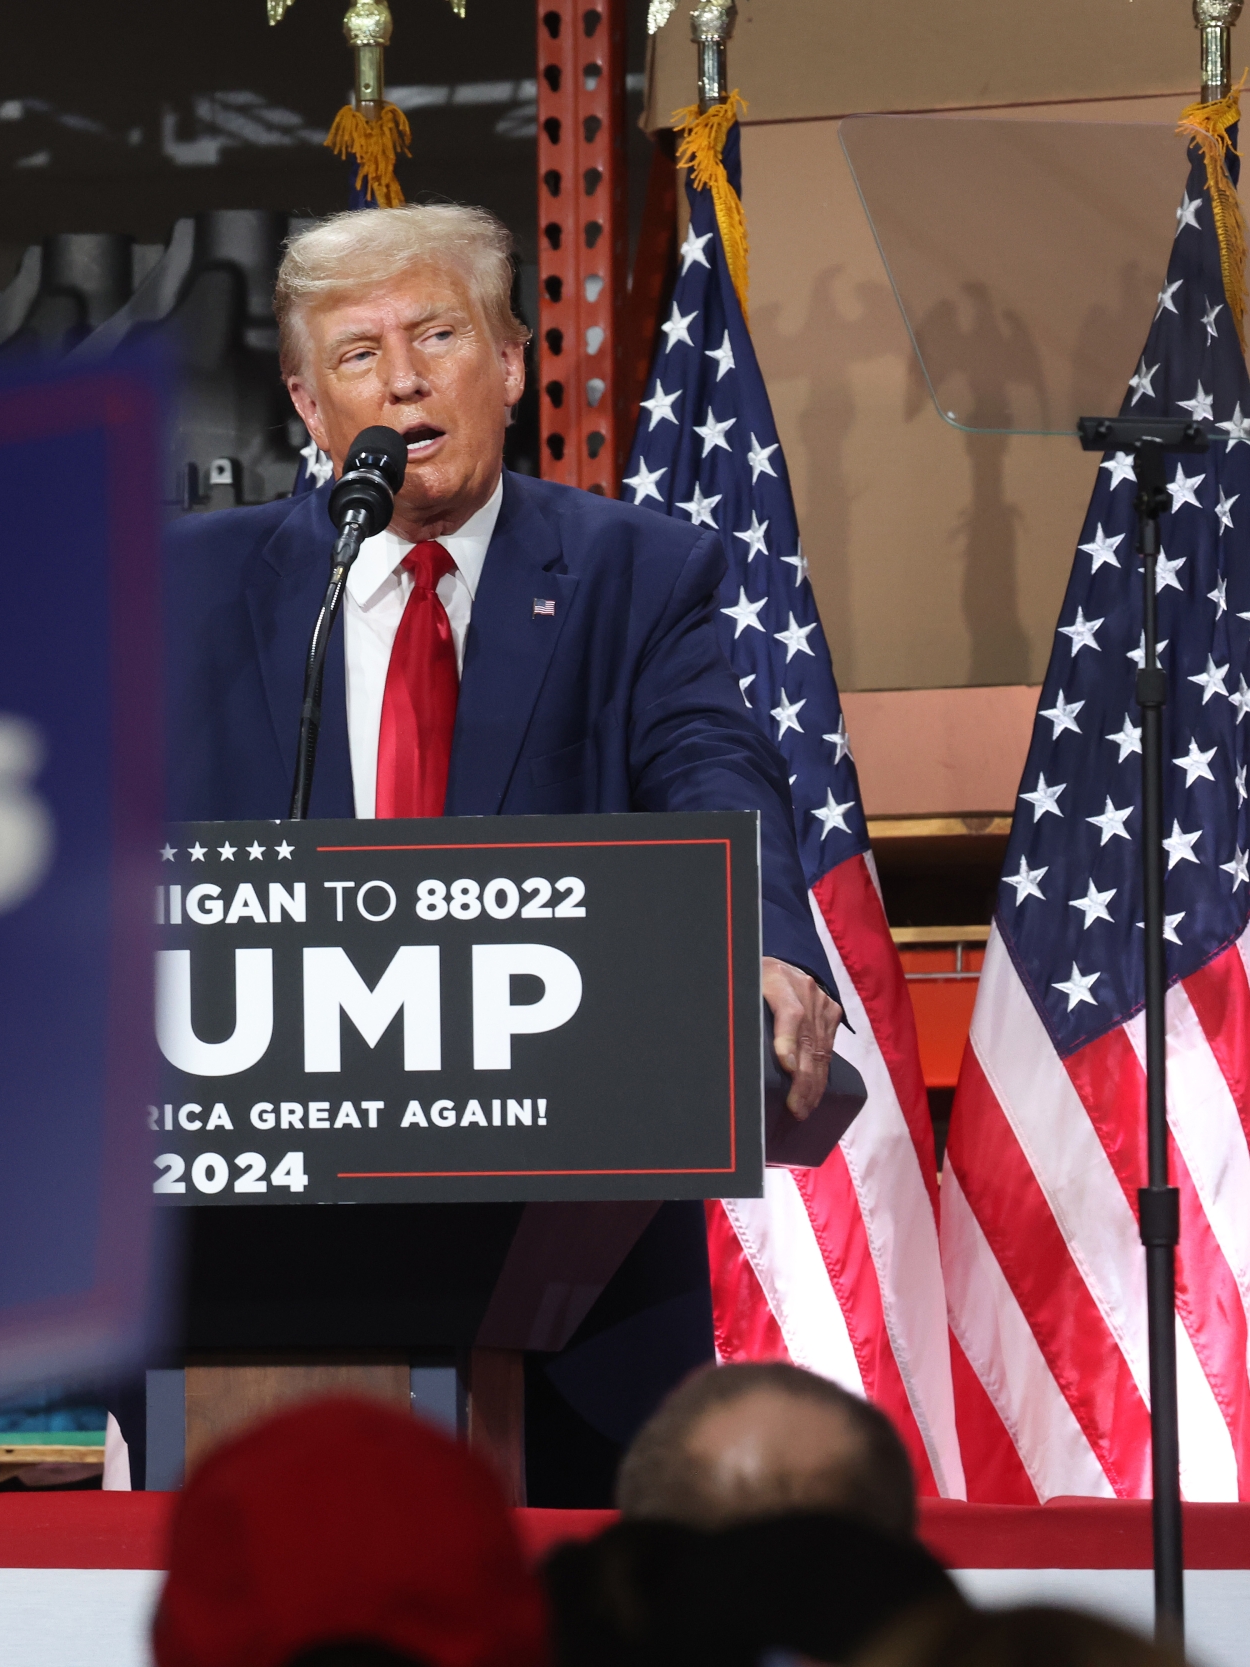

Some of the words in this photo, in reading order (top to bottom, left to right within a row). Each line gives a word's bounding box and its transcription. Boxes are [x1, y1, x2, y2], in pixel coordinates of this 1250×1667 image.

[324, 880, 398, 922] TO
[416, 877, 587, 920] 88022
[155, 943, 583, 1076] UMP
[250, 1101, 385, 1129] GREAT
[400, 1098, 548, 1127] AGAIN!
[153, 1152, 308, 1194] 2024
